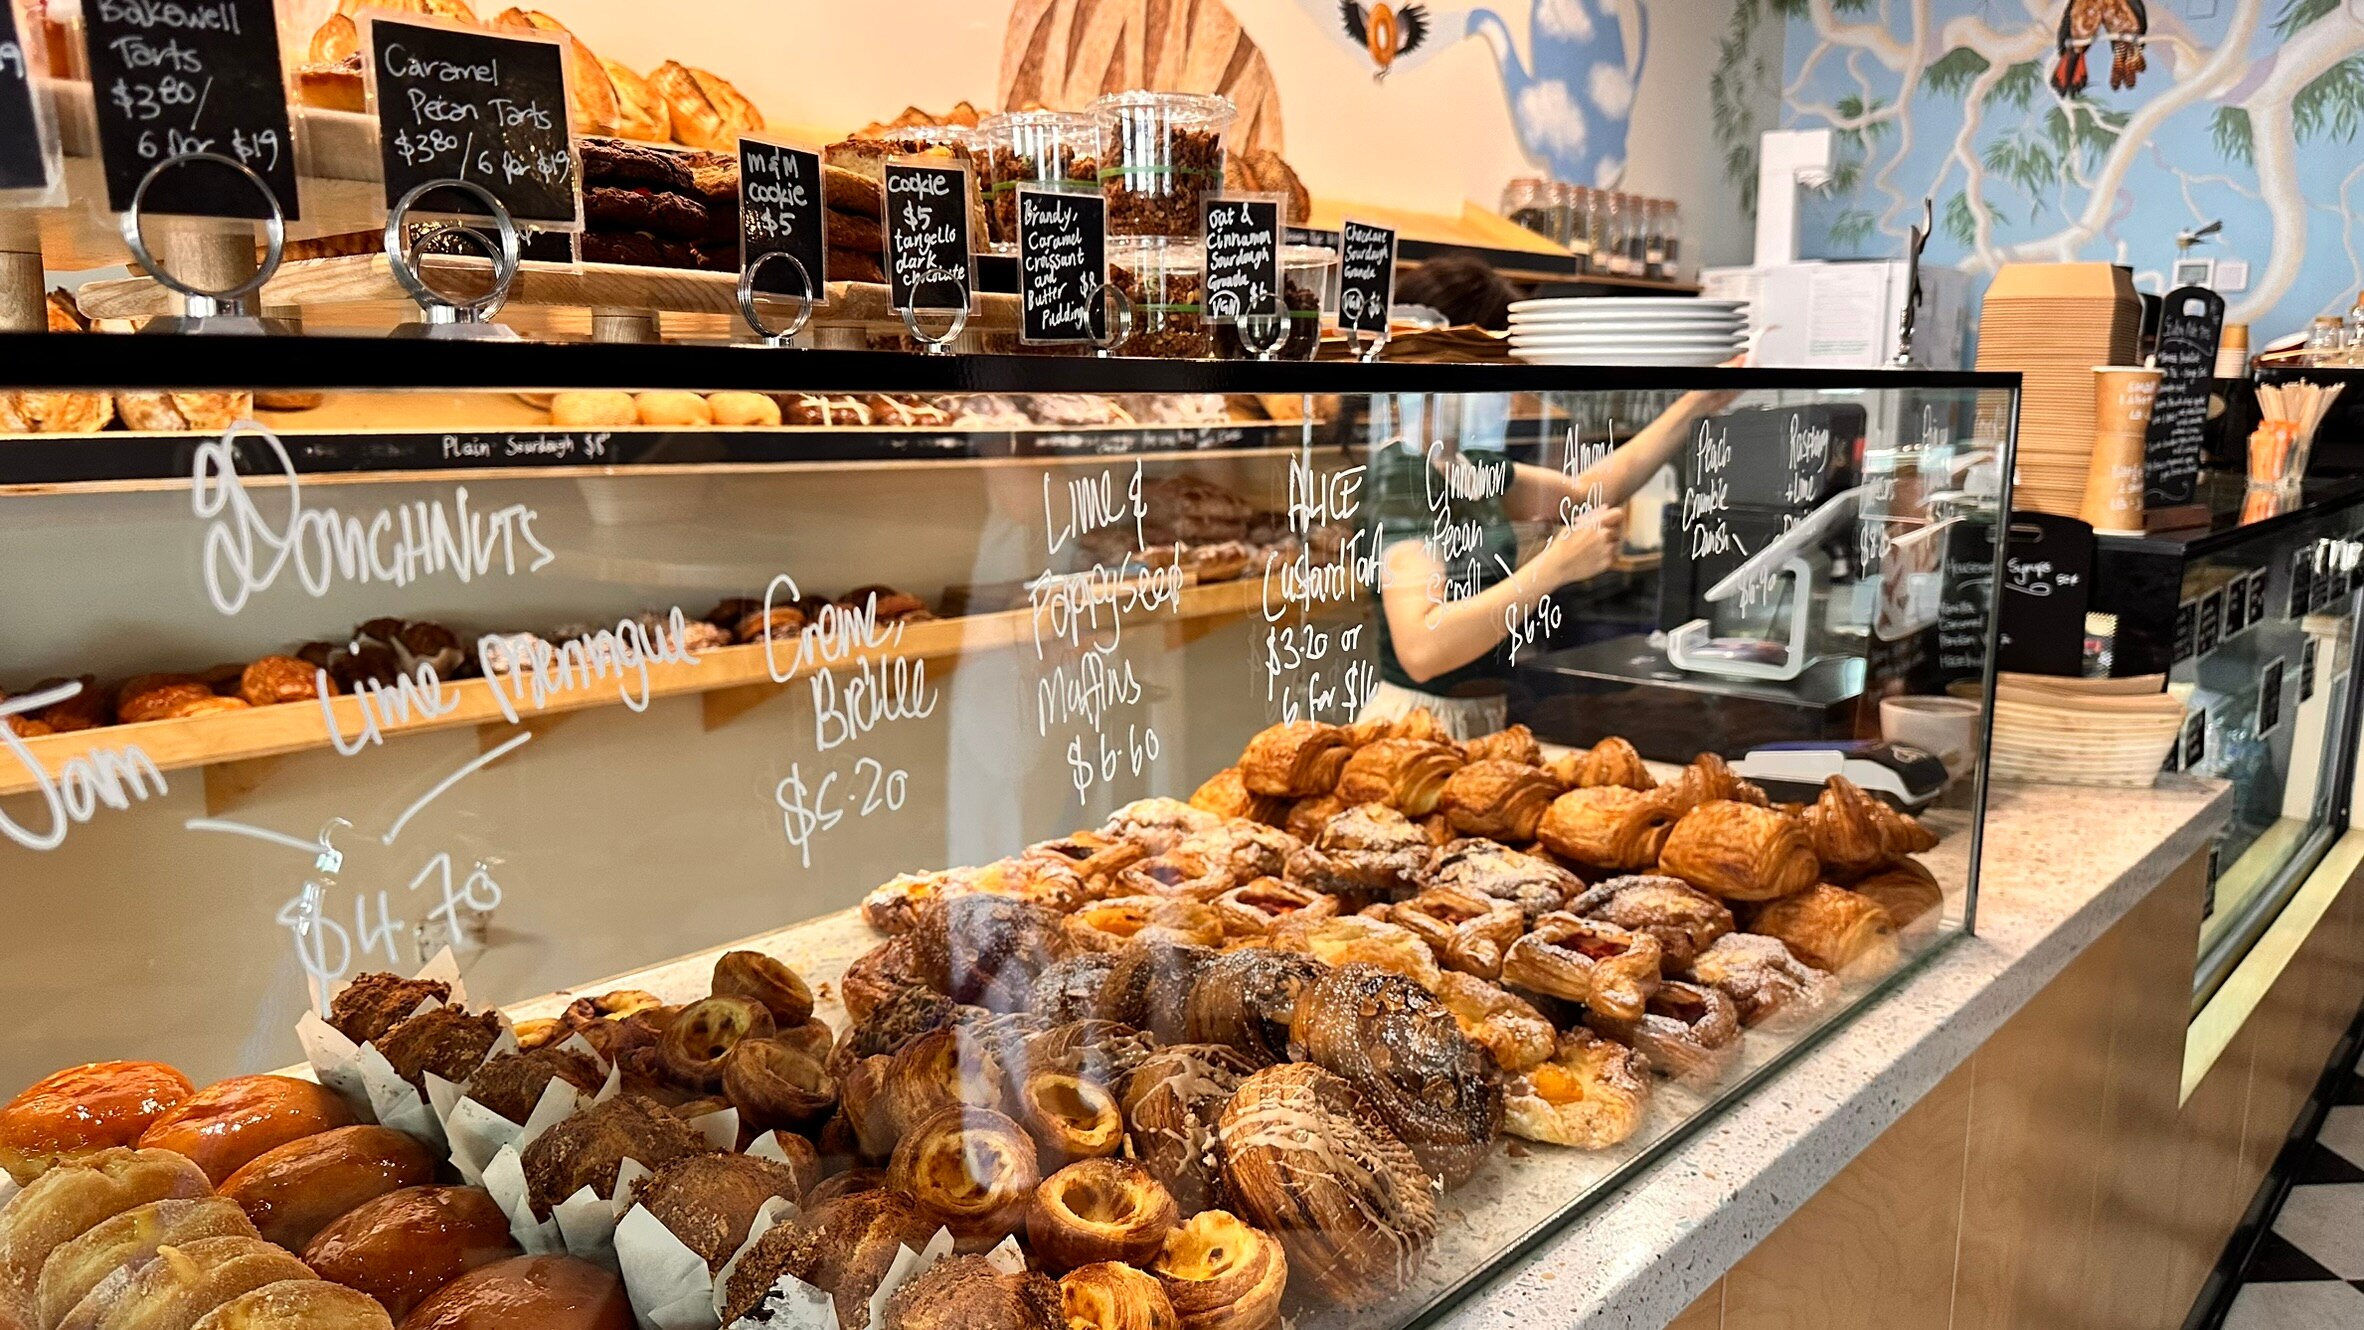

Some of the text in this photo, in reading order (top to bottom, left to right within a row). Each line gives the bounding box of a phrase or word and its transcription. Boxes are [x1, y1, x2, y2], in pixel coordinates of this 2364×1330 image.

[109, 35, 202, 72] Tarts
[384, 43, 499, 87] Caramel
[407, 88, 552, 130] Pecan Tarts
[137, 127, 278, 172] 6 for $19
[477, 150, 494, 176] 6
[501, 150, 531, 186] for
[536, 149, 571, 185] $19
[760, 206, 796, 238] $5
[902, 199, 933, 232] $5
[1208, 202, 1254, 229] Oat &
[894, 223, 956, 256] tangello
[1027, 226, 1083, 251] Caramel
[1206, 227, 1272, 250] Cinnamon
[895, 249, 938, 274] dark
[1034, 265, 1058, 288] and
[1210, 246, 1270, 271] Sourdough
[1027, 282, 1068, 311] Butter
[1079, 270, 1098, 299] $8
[1042, 300, 1086, 331] Pudding
[442, 434, 492, 460] Plain
[504, 433, 575, 459] Sourdough
[1562, 418, 1615, 494] Almond
[1696, 419, 1732, 485] Peach
[1426, 439, 1506, 512] Cinnamon
[1691, 518, 1730, 560] Danish
[1504, 594, 1563, 668] $6.90
[1264, 622, 1364, 702] $3.20 or
[1281, 685, 1300, 730] 6
[1308, 671, 1337, 730] for
[0, 680, 169, 851] Jam
[1066, 722, 1161, 806] $6.60
[774, 755, 910, 869] $5.20
